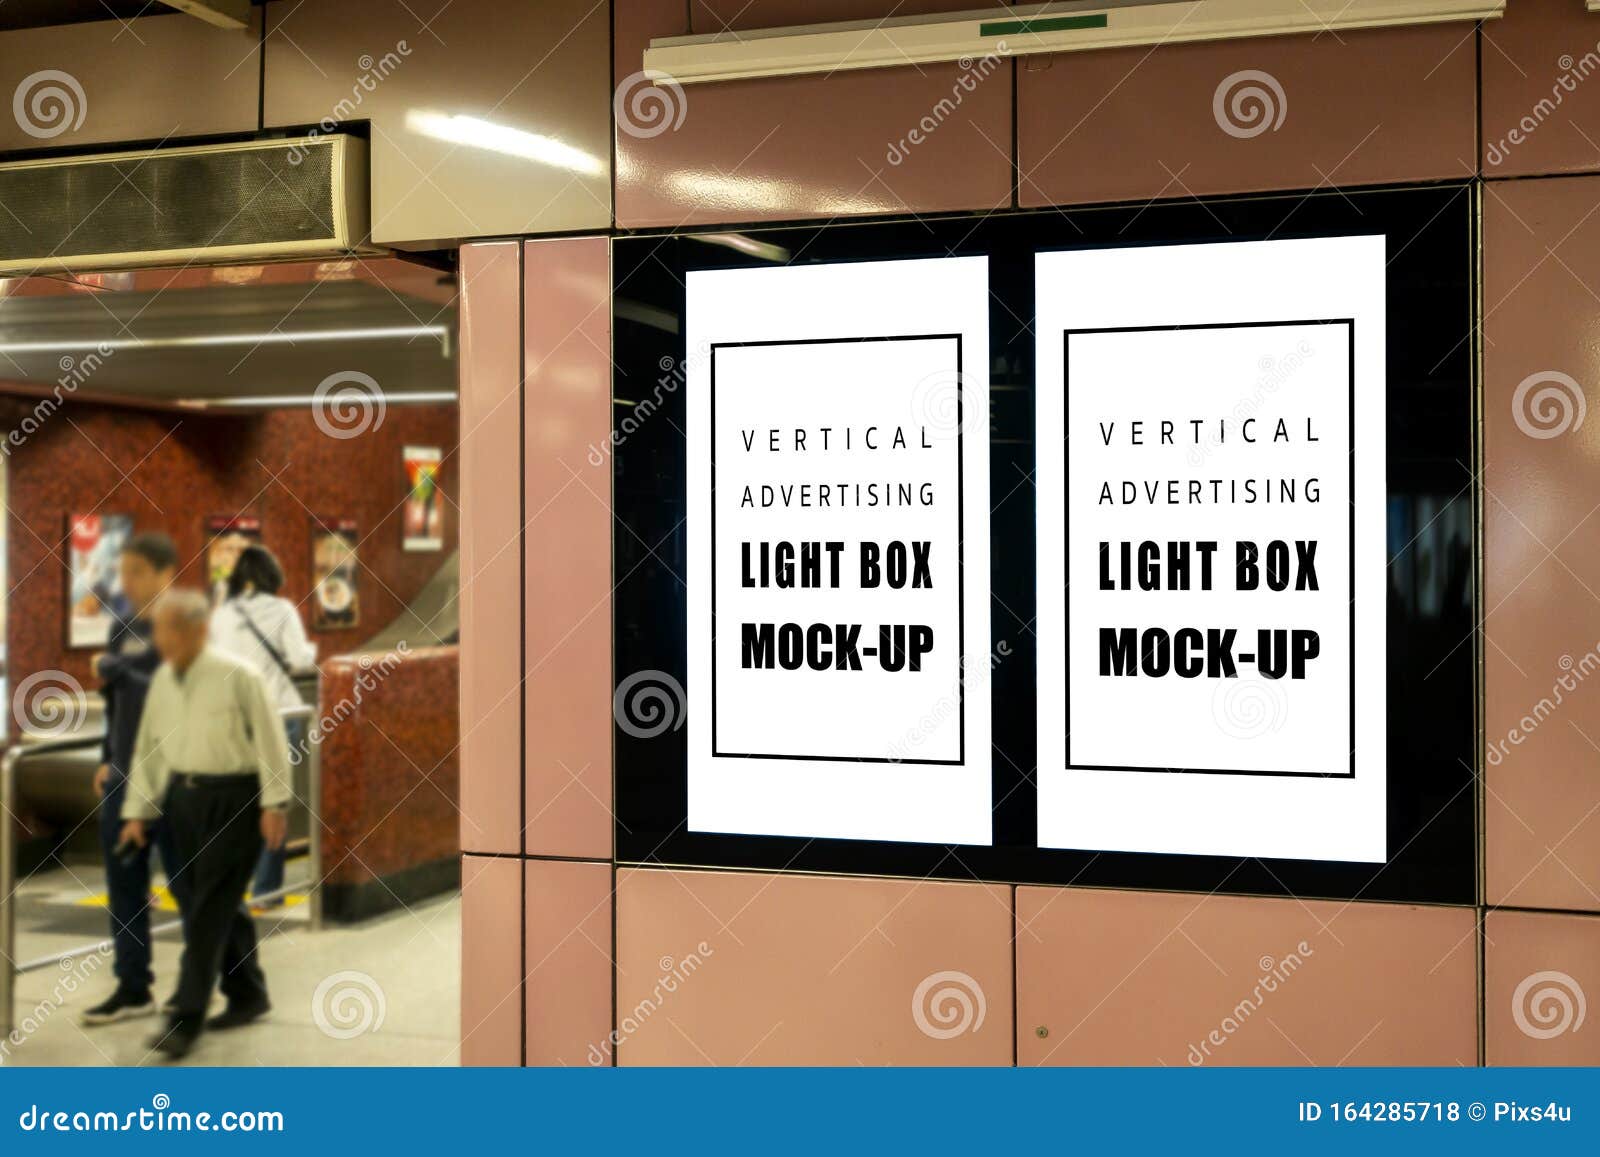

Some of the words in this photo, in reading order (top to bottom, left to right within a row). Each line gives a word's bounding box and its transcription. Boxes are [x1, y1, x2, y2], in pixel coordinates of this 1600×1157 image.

[742, 427, 932, 452] VERTICAL
[1099, 417, 1319, 446] VERTICAL
[741, 482, 933, 508] ADVERTISING
[1099, 478, 1320, 505] ADVERTISING
[741, 541, 845, 589] LIGHT
[860, 540, 933, 589] BOX
[1099, 540, 1218, 592] LIGHT
[1235, 540, 1320, 592] BOX
[741, 622, 934, 672] MOCK-UP
[1099, 627, 1320, 680] MOCK-UP
